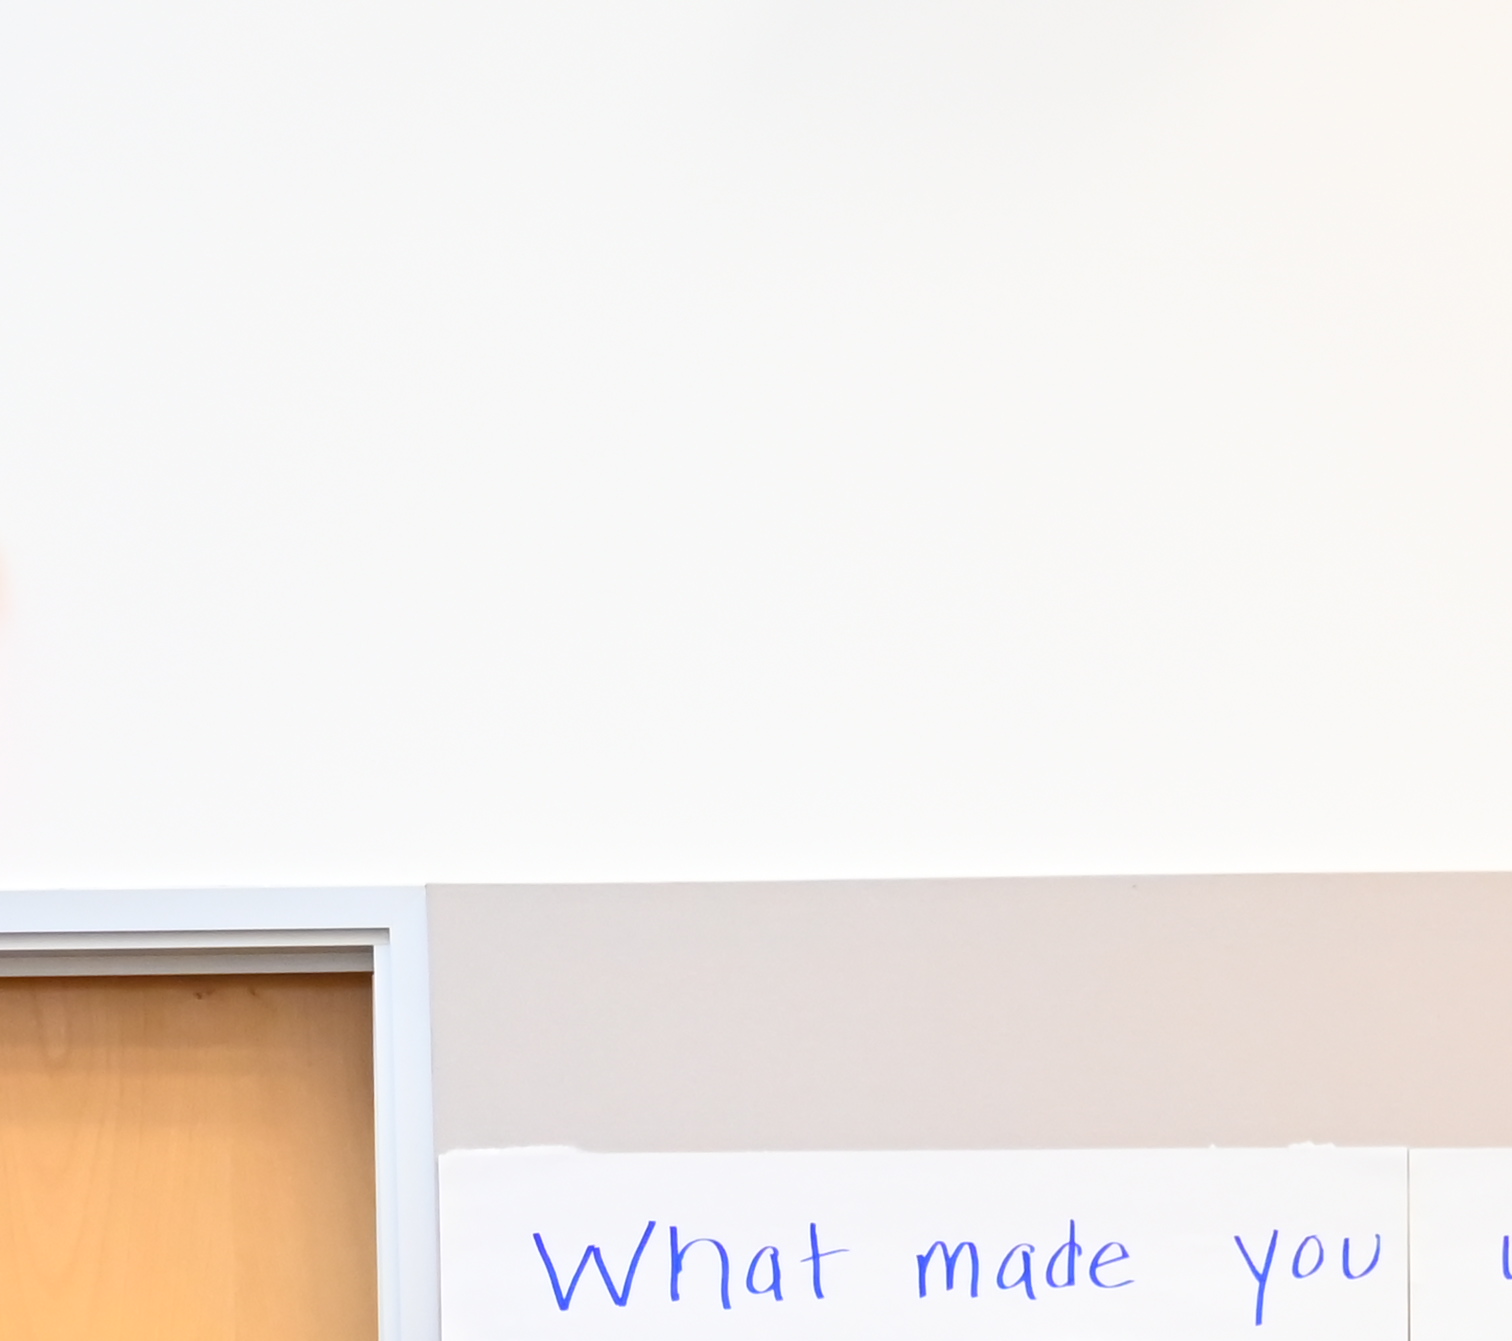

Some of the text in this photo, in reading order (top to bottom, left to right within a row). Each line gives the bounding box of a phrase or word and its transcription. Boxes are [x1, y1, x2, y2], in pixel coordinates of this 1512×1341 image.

[532, 1220, 849, 1310] What
[915, 1218, 1134, 1301] made
[1233, 1229, 1382, 1325] you
